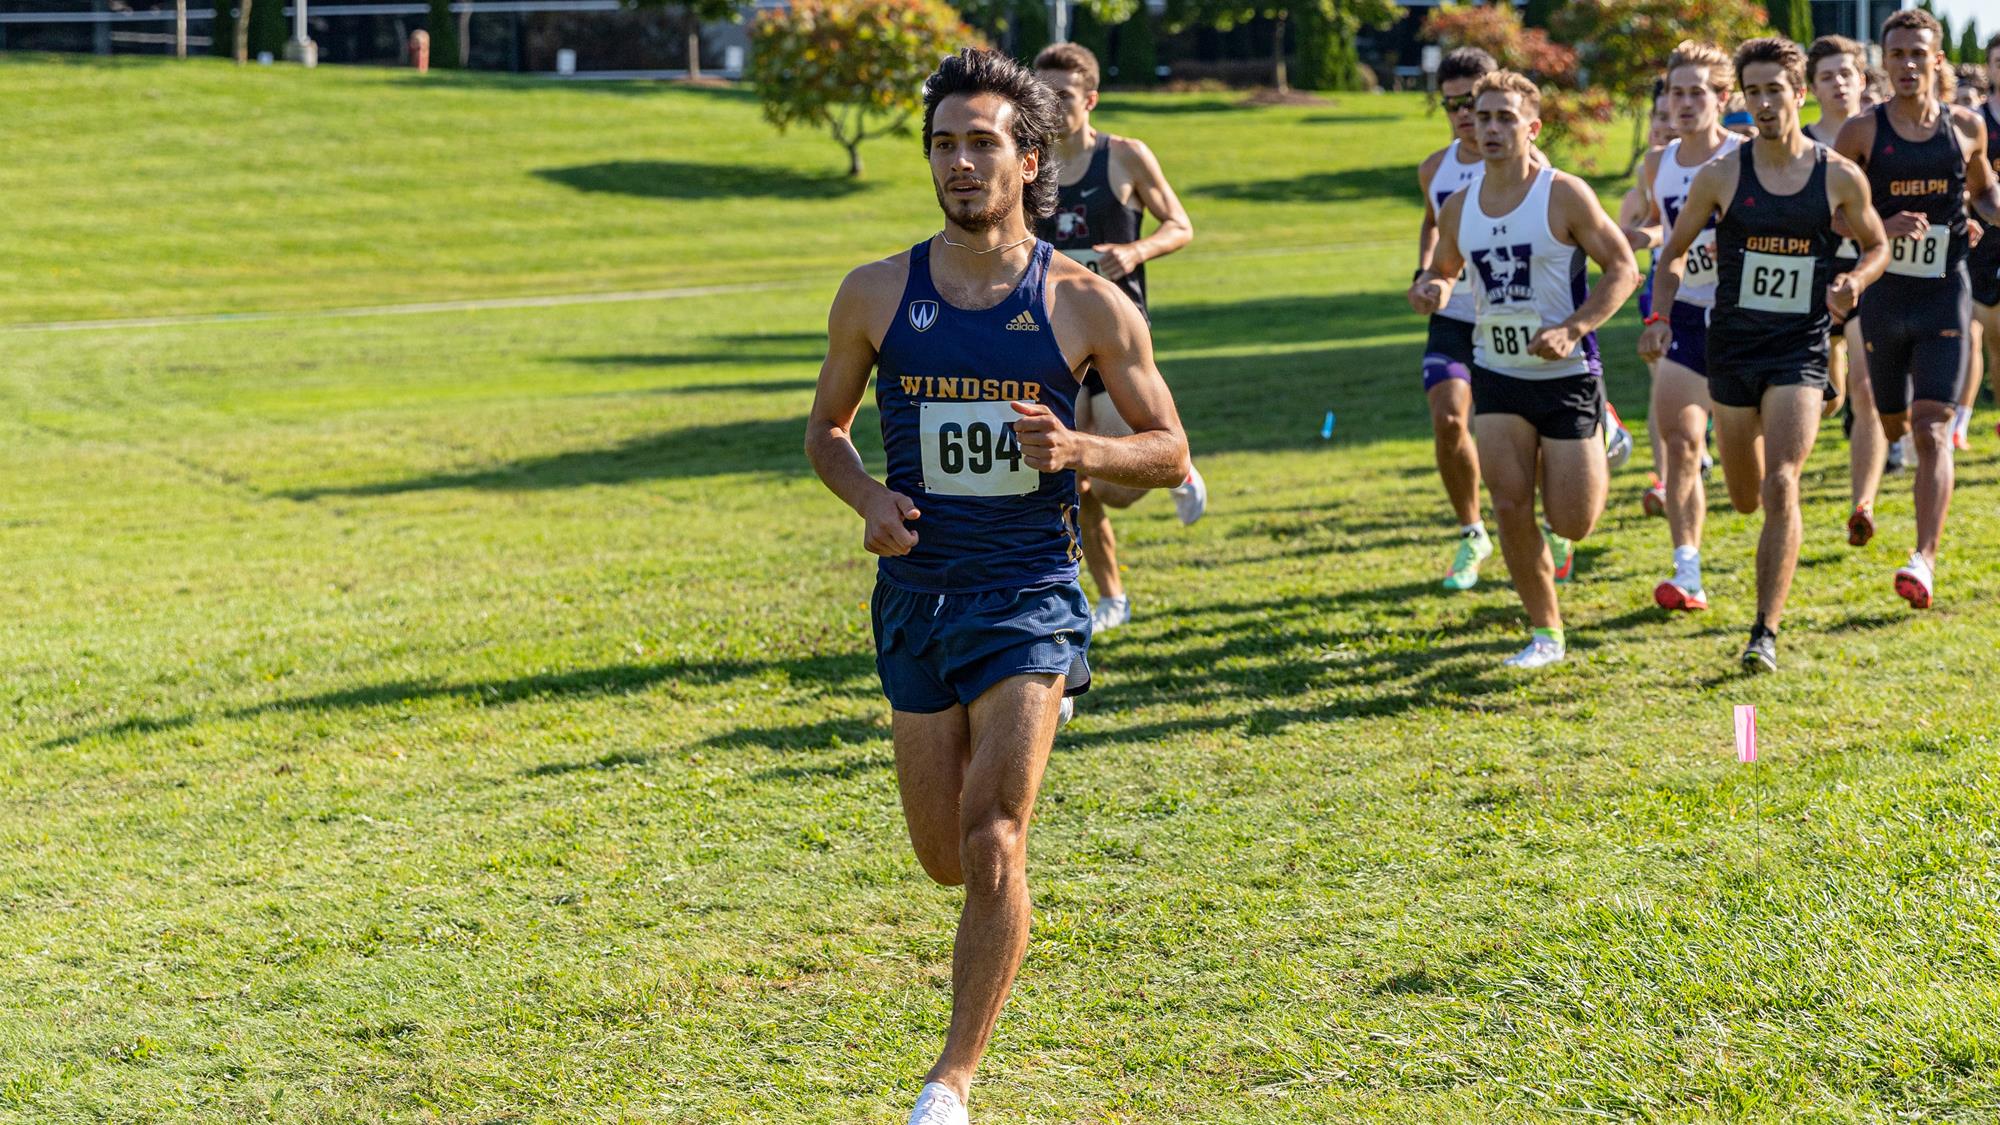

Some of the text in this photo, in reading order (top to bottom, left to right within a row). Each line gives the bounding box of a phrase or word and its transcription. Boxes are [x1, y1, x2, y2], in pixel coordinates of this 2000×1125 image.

[1890, 180, 1948, 196] GUELPH
[1746, 236, 1811, 254] GUELPH
[1893, 236, 1936, 264] 618
[1753, 266, 1800, 299] 621
[1005, 321, 1040, 332] adidas
[1491, 325, 1531, 355] 681
[899, 375, 1041, 401] WINDSOR
[938, 421, 1022, 474] 694
